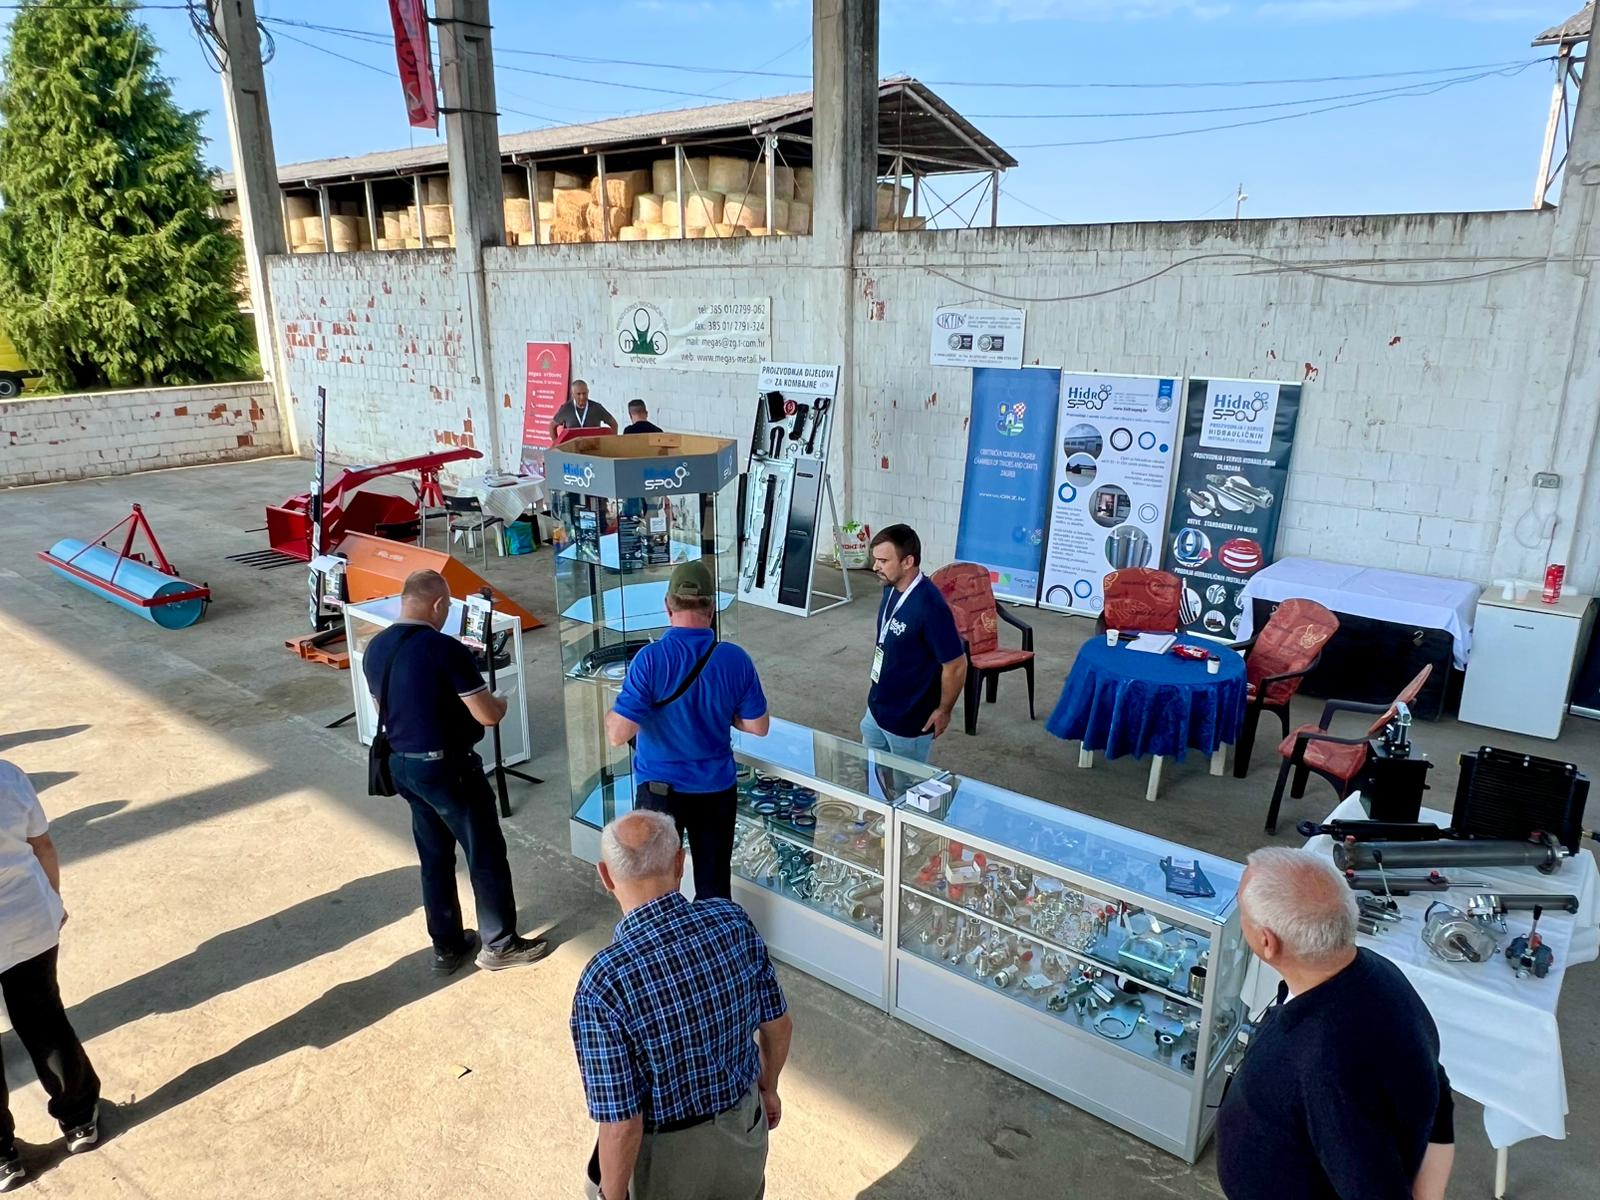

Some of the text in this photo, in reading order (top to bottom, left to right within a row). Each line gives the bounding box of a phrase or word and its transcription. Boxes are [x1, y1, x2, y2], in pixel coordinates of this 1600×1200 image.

[630, 355, 657, 365] vrbovec
[761, 366, 834, 379] PROIZVODNJA DIJELOVA
[774, 379, 817, 389] ZA KOMBAJNE
